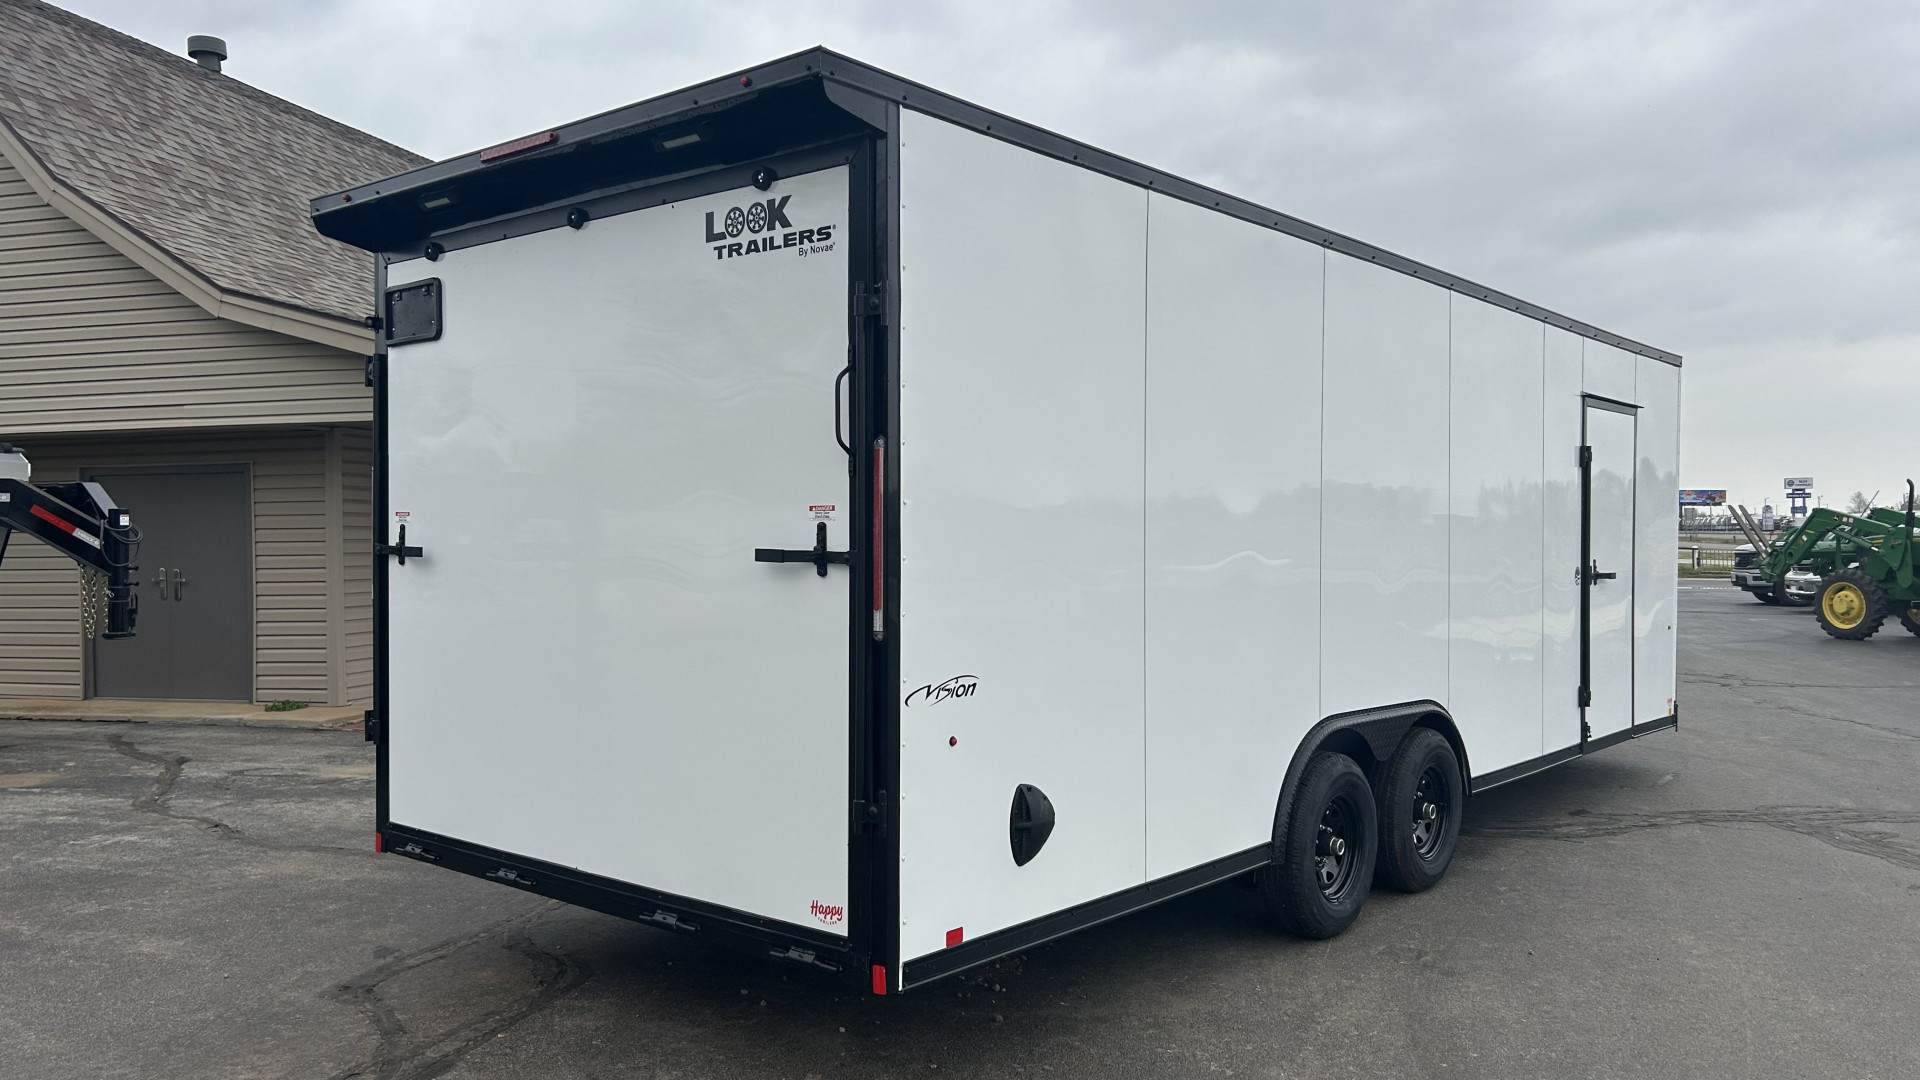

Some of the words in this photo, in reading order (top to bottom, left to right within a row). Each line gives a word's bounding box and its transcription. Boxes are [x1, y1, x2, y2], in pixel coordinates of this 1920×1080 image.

[705, 194, 793, 243] LOOK
[713, 225, 833, 260] TRAILERS
[798, 247, 809, 258] By
[810, 244, 834, 255] Novae
[905, 674, 980, 708] Vision
[810, 899, 844, 922] Happy
